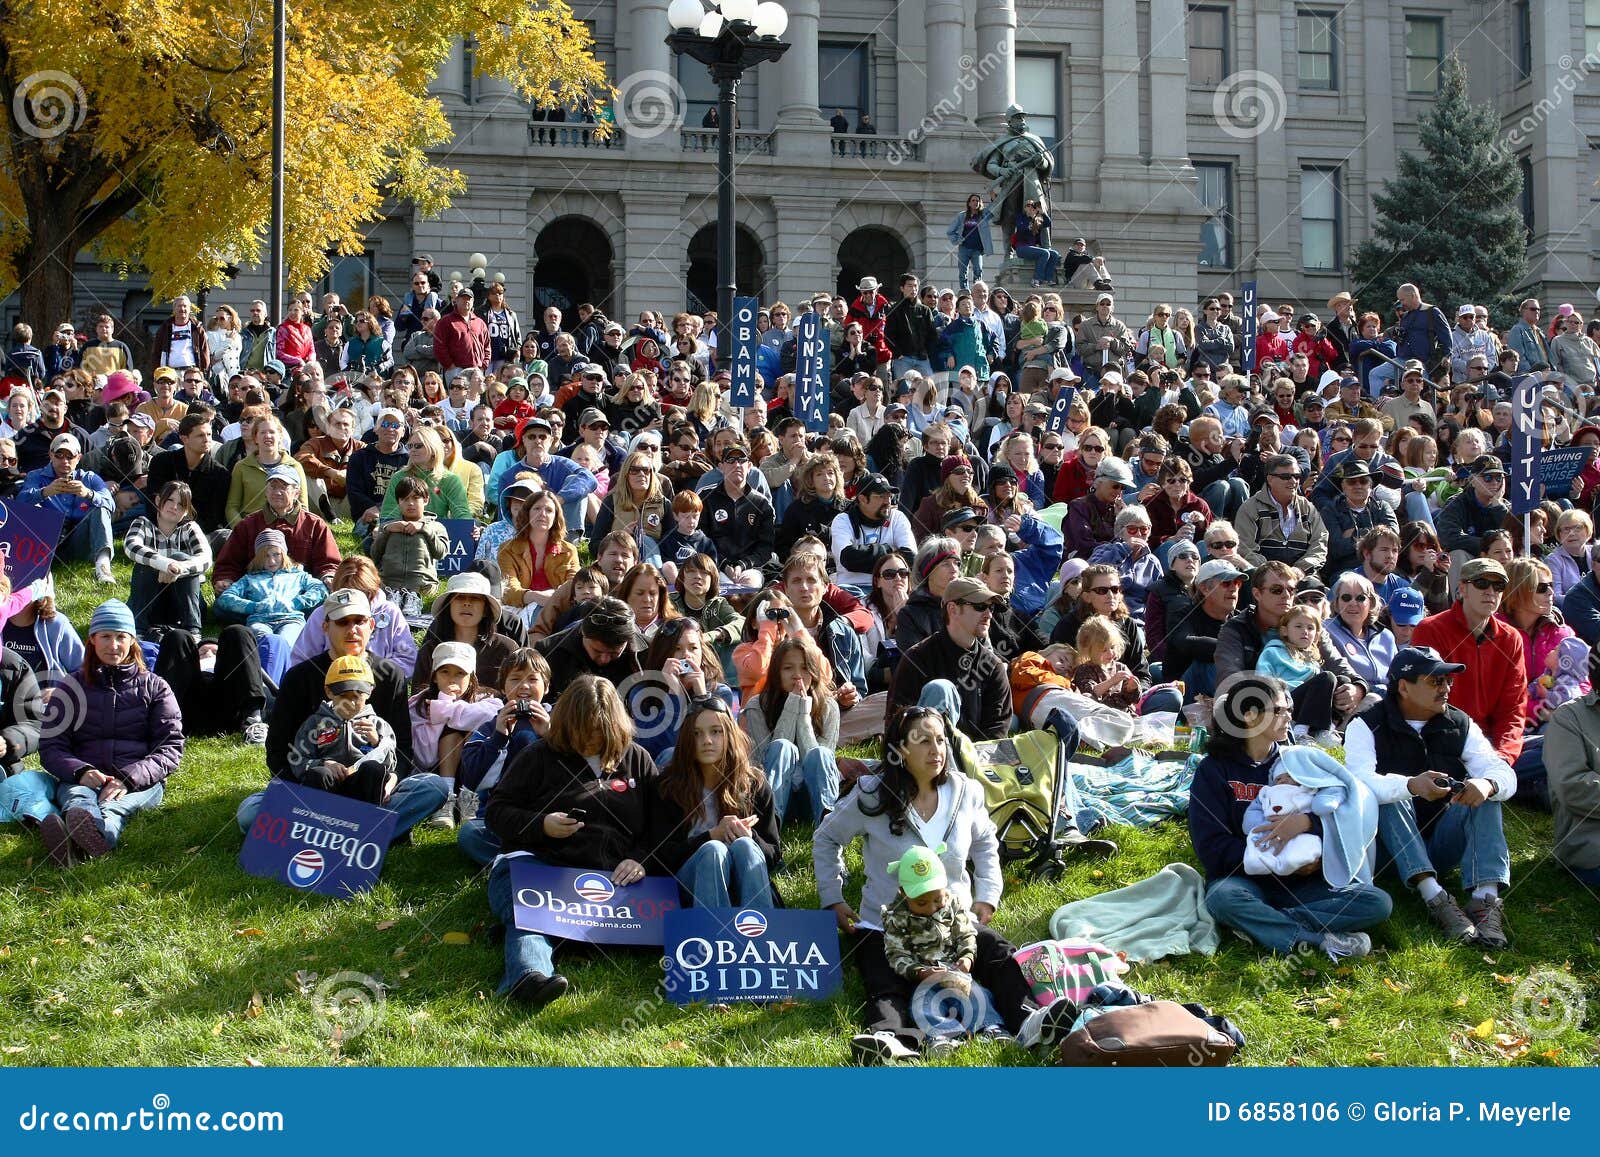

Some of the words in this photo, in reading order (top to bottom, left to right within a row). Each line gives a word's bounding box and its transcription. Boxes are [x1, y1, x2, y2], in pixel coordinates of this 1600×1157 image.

[488, 322, 509, 339] 08
[1244, 290, 1253, 361] UNITY
[736, 308, 752, 397] OBAMA
[800, 323, 815, 411] UNITY
[1051, 398, 1066, 430] OB
[1520, 387, 1536, 500] UNITY
[1541, 452, 1583, 463] NEWING
[1540, 461, 1579, 472] ERICA'S
[5, 640, 36, 652] Obama
[252, 812, 289, 847] '08
[290, 821, 381, 870] Obama
[517, 888, 634, 919] Obama
[555, 915, 642, 929] BarackObama.com
[675, 937, 829, 969] OBAMA
[688, 967, 819, 993] BIDEN
